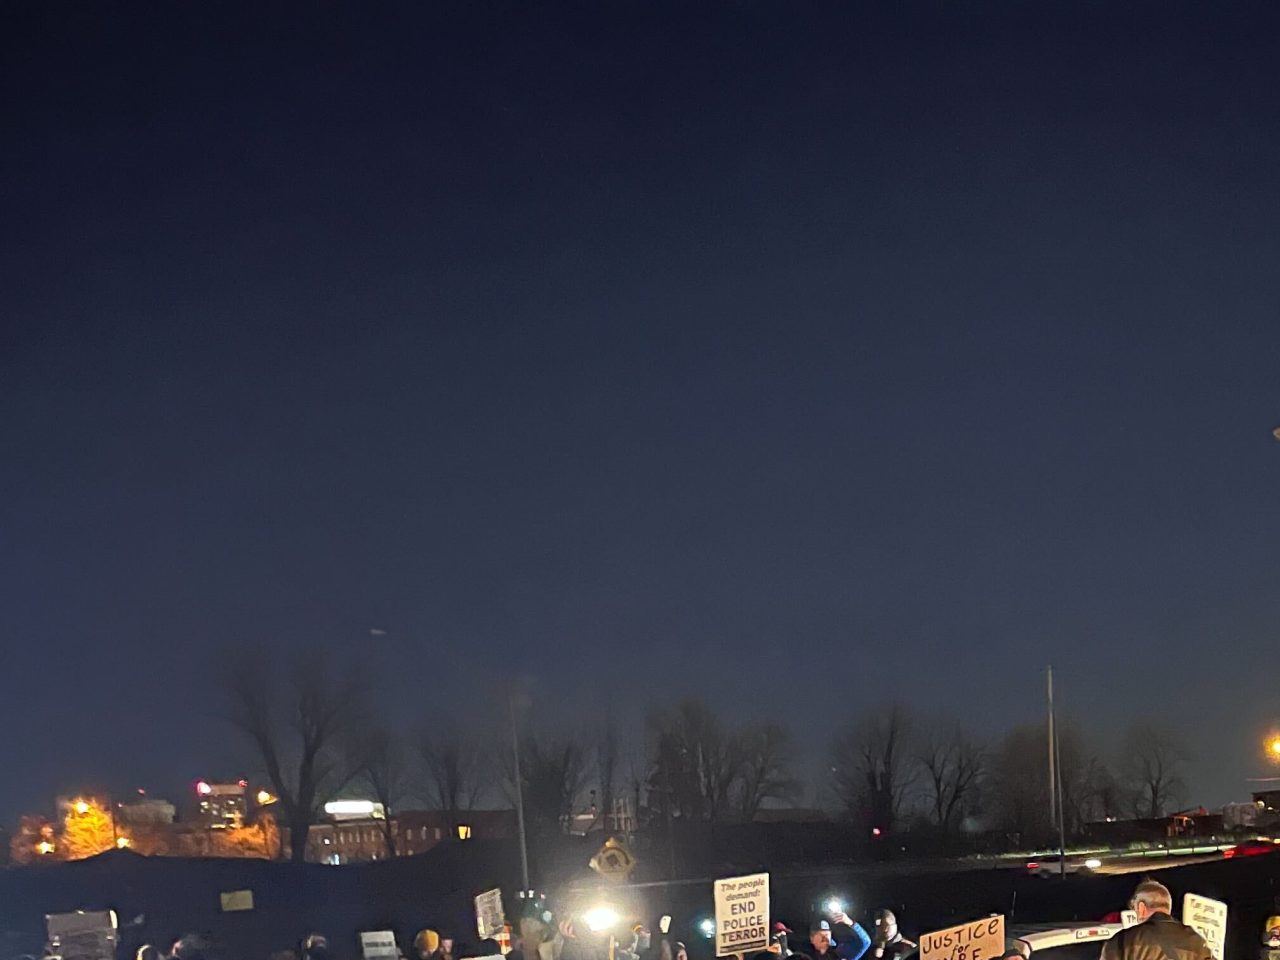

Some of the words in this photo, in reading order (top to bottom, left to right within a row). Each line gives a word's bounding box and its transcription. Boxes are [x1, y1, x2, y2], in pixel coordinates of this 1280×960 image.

[721, 883, 736, 892] The
[731, 901, 756, 915] END
[723, 915, 763, 930] POLICE
[721, 927, 766, 943] TERROR
